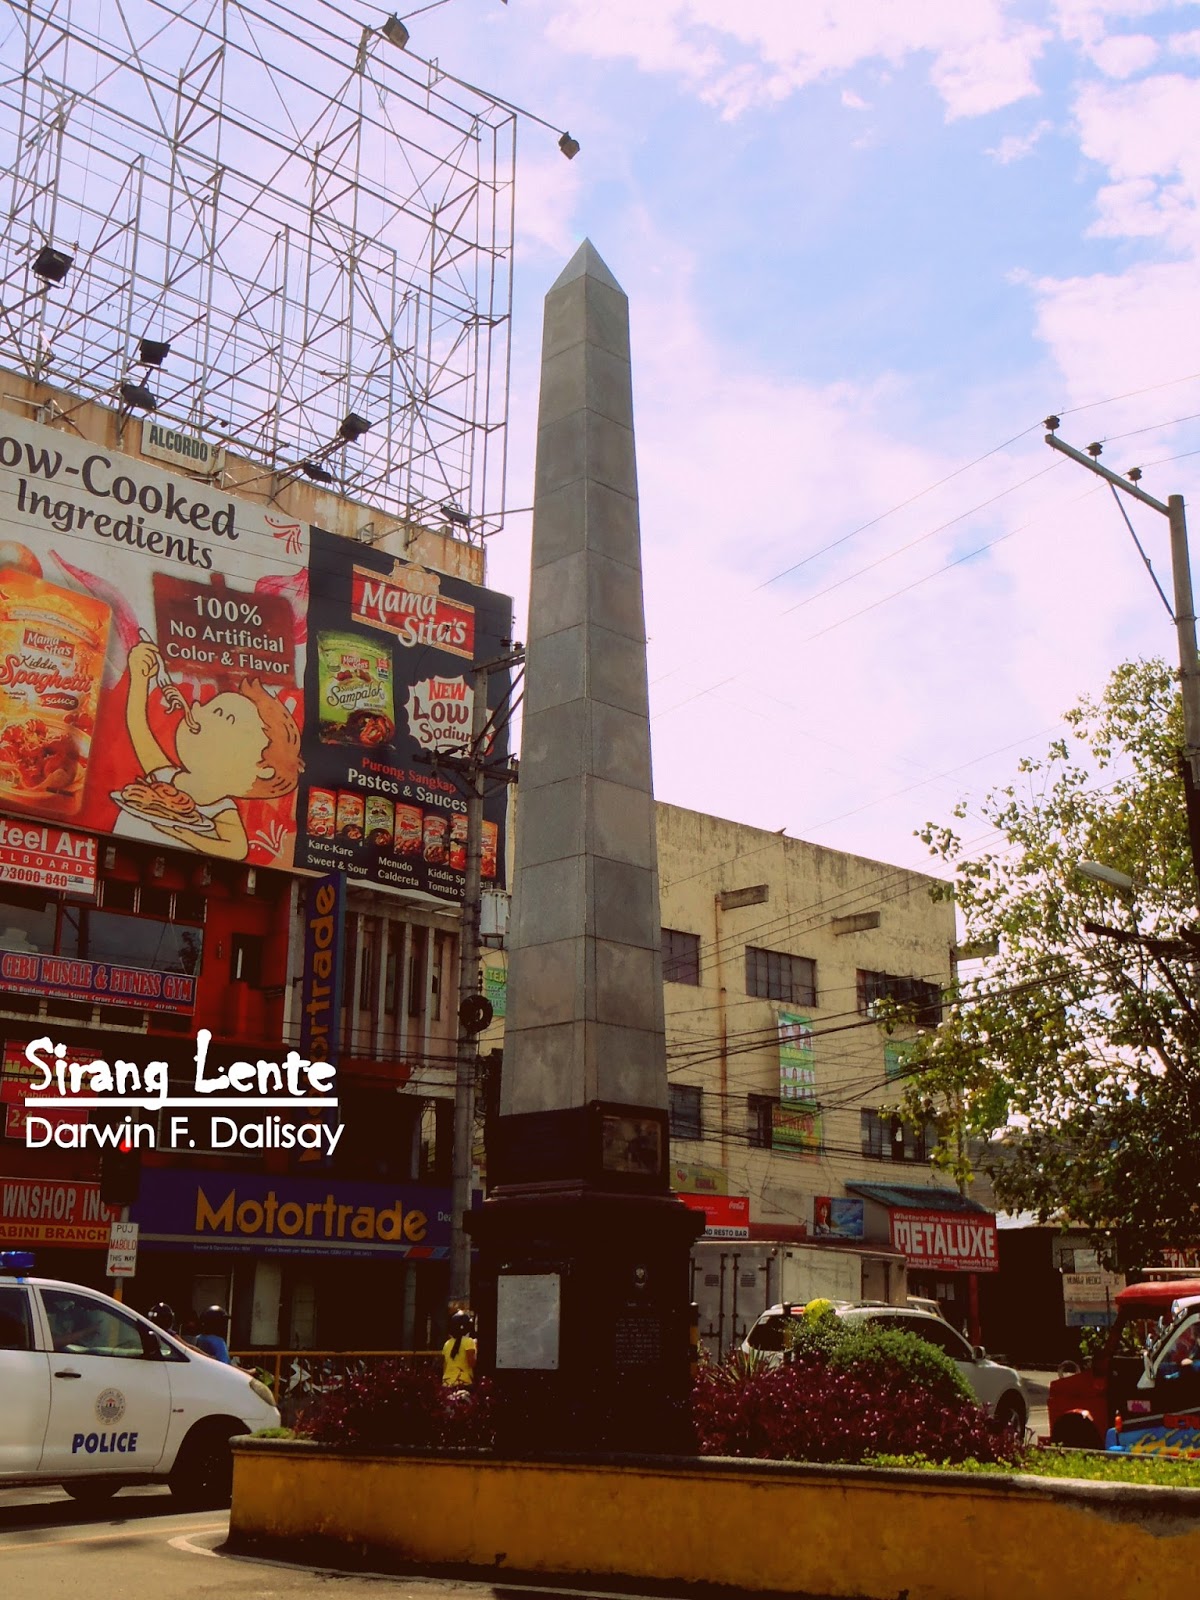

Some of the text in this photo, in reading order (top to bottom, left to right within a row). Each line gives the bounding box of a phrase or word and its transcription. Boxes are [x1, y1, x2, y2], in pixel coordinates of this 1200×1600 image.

[149, 425, 208, 462] ALCORDO
[17, 478, 213, 569] Ingredients
[194, 595, 262, 626] 100%
[360, 582, 437, 622] Mama
[26, 632, 60, 647] Mama
[170, 619, 284, 653] No Artificial
[398, 616, 467, 648] Sita's
[20, 653, 58, 671] Kiddie
[166, 642, 290, 674] Color & Flavor
[45, 697, 76, 706] sauce
[428, 680, 468, 701] NEW
[362, 757, 405, 782] Purong
[348, 768, 468, 813] Pastes & Sauces
[55, 832, 96, 860] Art
[308, 839, 354, 857] Kare-Kare
[307, 854, 368, 875] Sweet & Sour
[378, 856, 413, 872] Menudo
[427, 868, 454, 882] Kiddie
[378, 869, 419, 887] Caldereta
[427, 881, 458, 895] Tomato
[2, 953, 193, 1001] CEBU MUSCLE & FITNESS GYM
[195, 1185, 428, 1242] Motortrade
[45, 1227, 107, 1241] BRANCH
[116, 1225, 133, 1233] PUJ
[893, 1220, 995, 1258] METALUXE
[72, 1432, 138, 1453] POLICE
